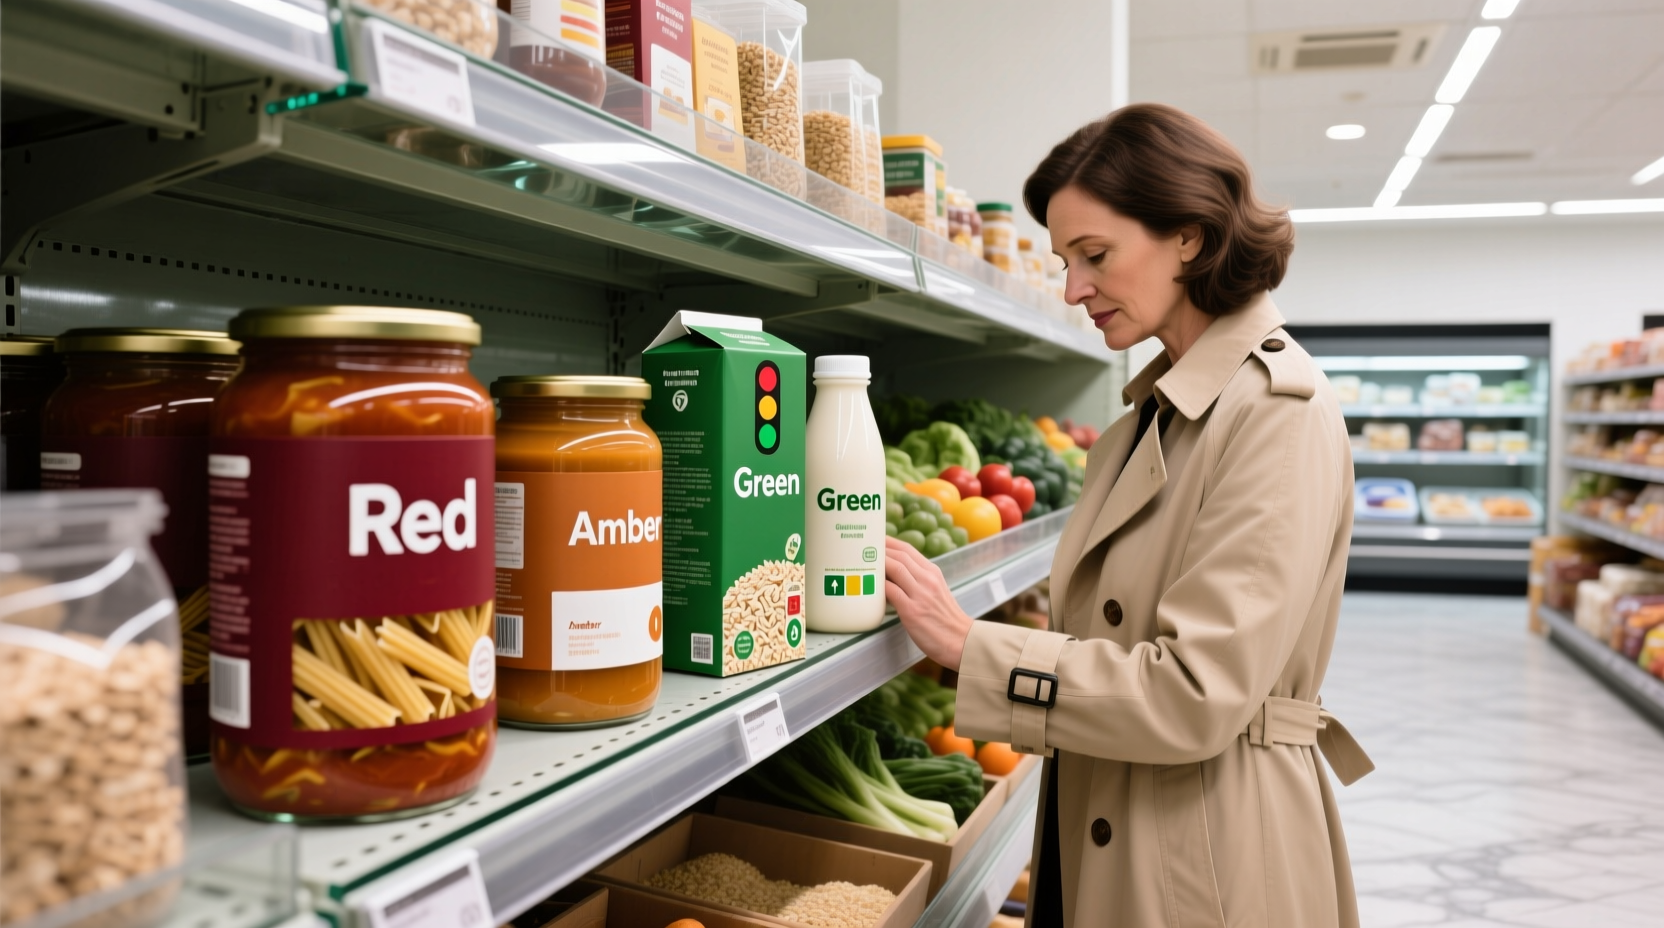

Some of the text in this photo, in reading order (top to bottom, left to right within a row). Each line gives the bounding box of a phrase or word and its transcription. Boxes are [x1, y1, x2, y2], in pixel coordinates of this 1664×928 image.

[733, 466, 800, 499] Green
[816, 487, 882, 513] Green
[348, 477, 477, 557] Red
[567, 508, 663, 546] Amber
